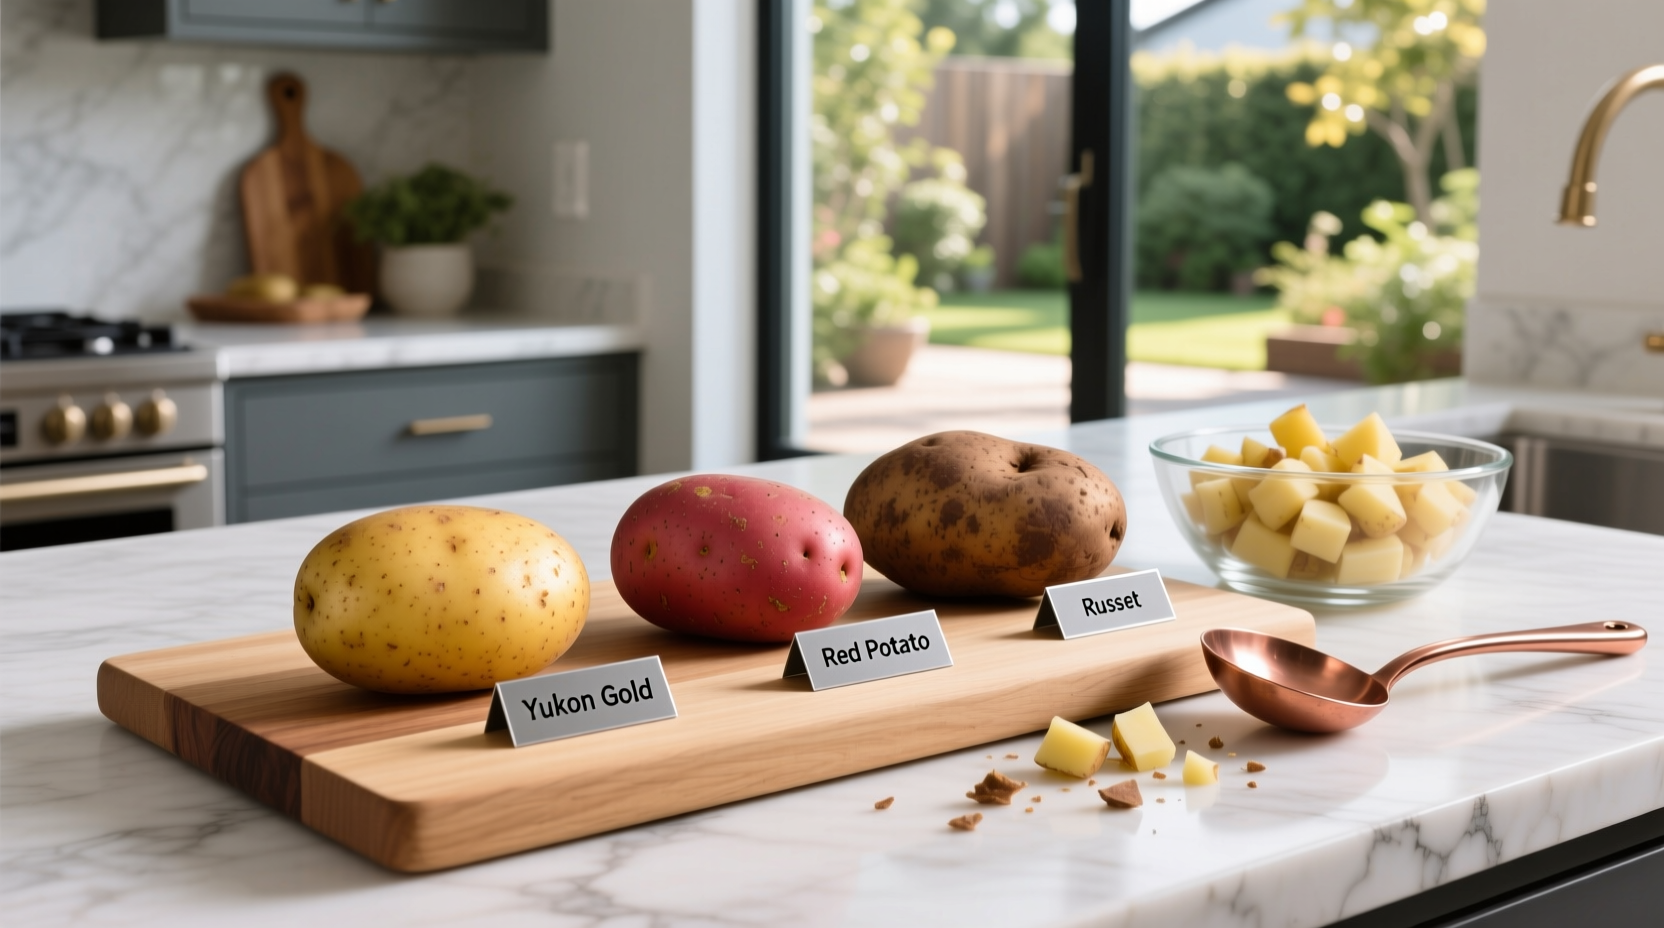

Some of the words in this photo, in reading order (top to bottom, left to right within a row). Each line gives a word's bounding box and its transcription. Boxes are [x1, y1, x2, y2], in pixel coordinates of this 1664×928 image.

[1081, 590, 1142, 617] Russet
[821, 641, 862, 668] Red
[864, 633, 930, 660] Potato
[521, 693, 596, 721] Yukon
[600, 677, 654, 707] Gold
